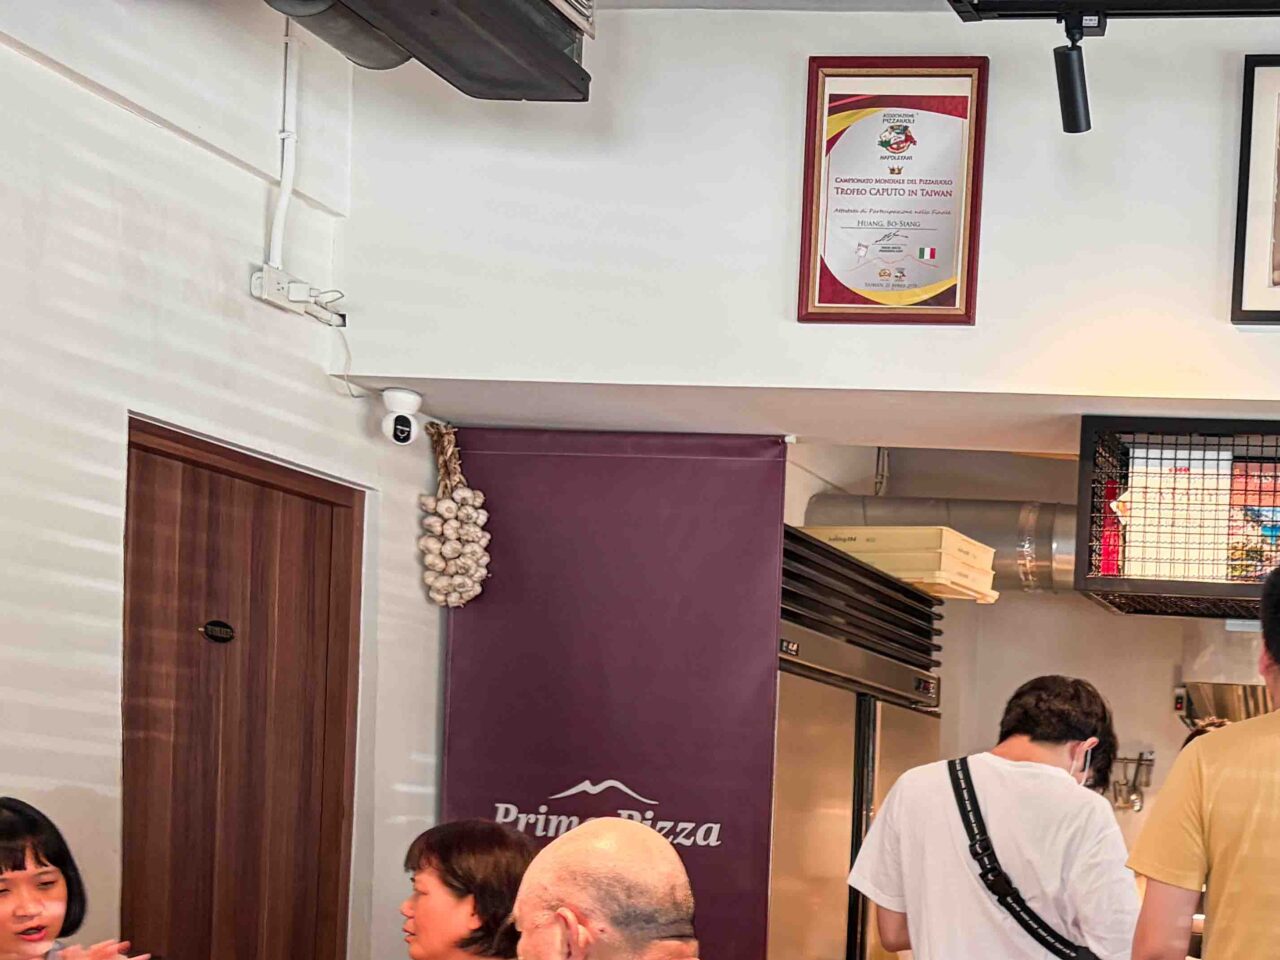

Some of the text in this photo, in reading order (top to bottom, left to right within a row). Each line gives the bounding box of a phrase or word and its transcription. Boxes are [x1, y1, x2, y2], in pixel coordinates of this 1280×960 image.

[834, 187, 953, 197] TROFEO CAPUTO IN TAIWAN
[494, 803, 598, 838] Prim
